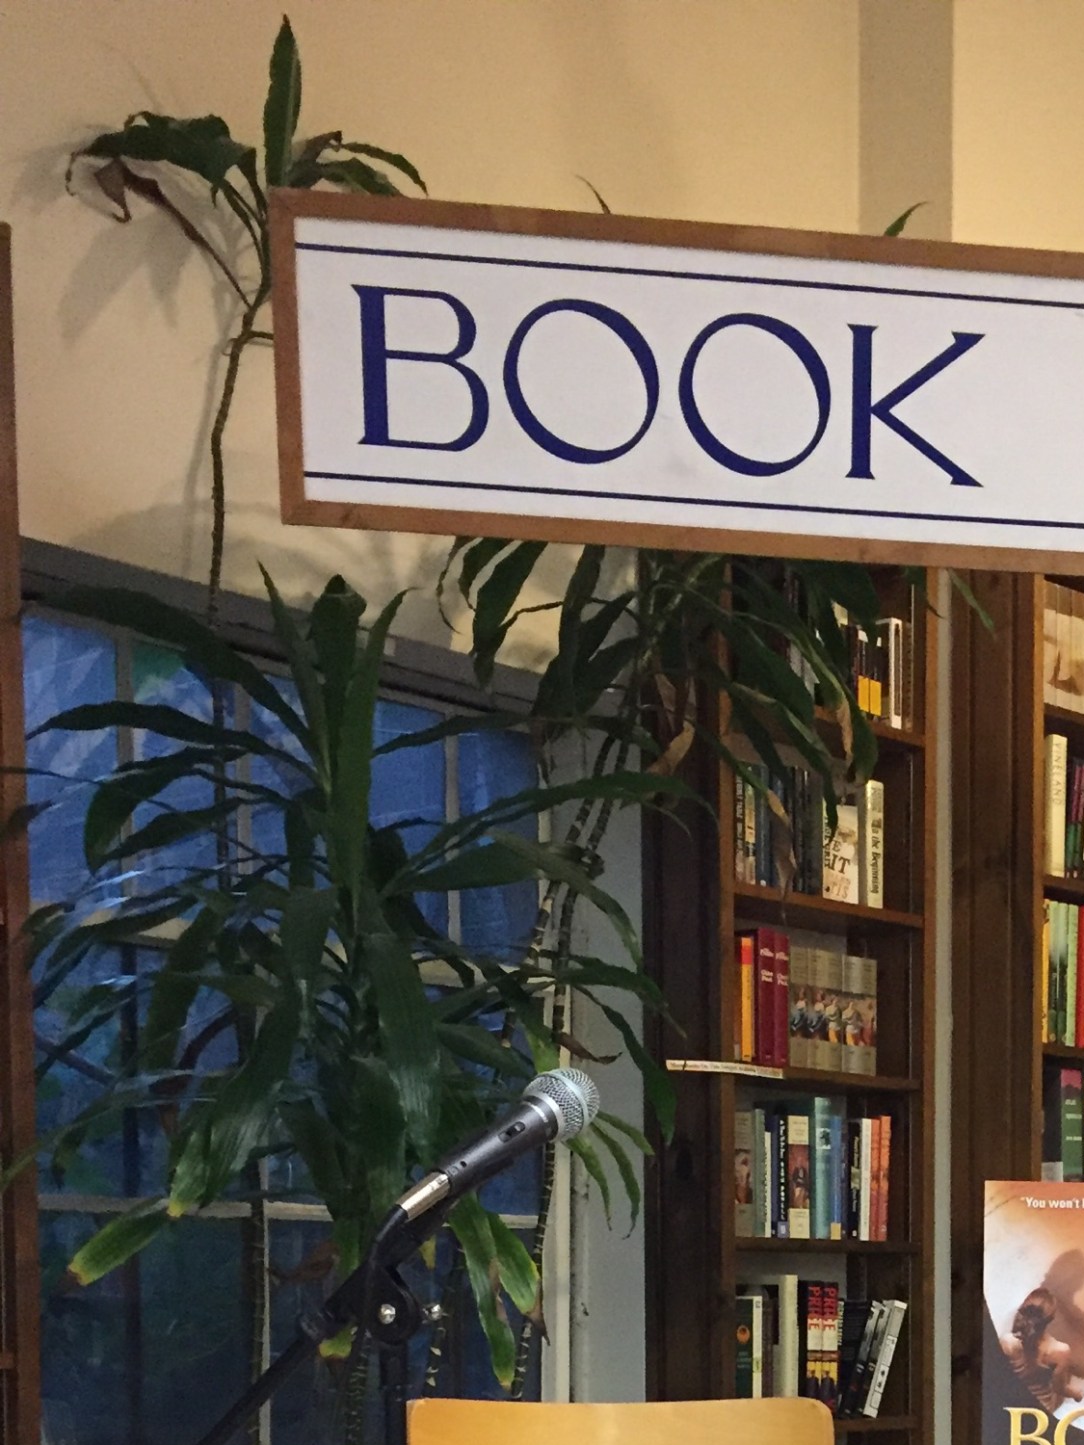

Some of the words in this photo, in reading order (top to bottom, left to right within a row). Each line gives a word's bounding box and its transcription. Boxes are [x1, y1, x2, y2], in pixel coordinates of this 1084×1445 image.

[352, 284, 985, 488] BOOK
[1052, 741, 1063, 807] VINELAND
[869, 851, 881, 895] Beginning
[1048, 1198, 1081, 1210] won't
[807, 1285, 821, 1332] PRICE
[822, 1285, 838, 1332] PRICE
